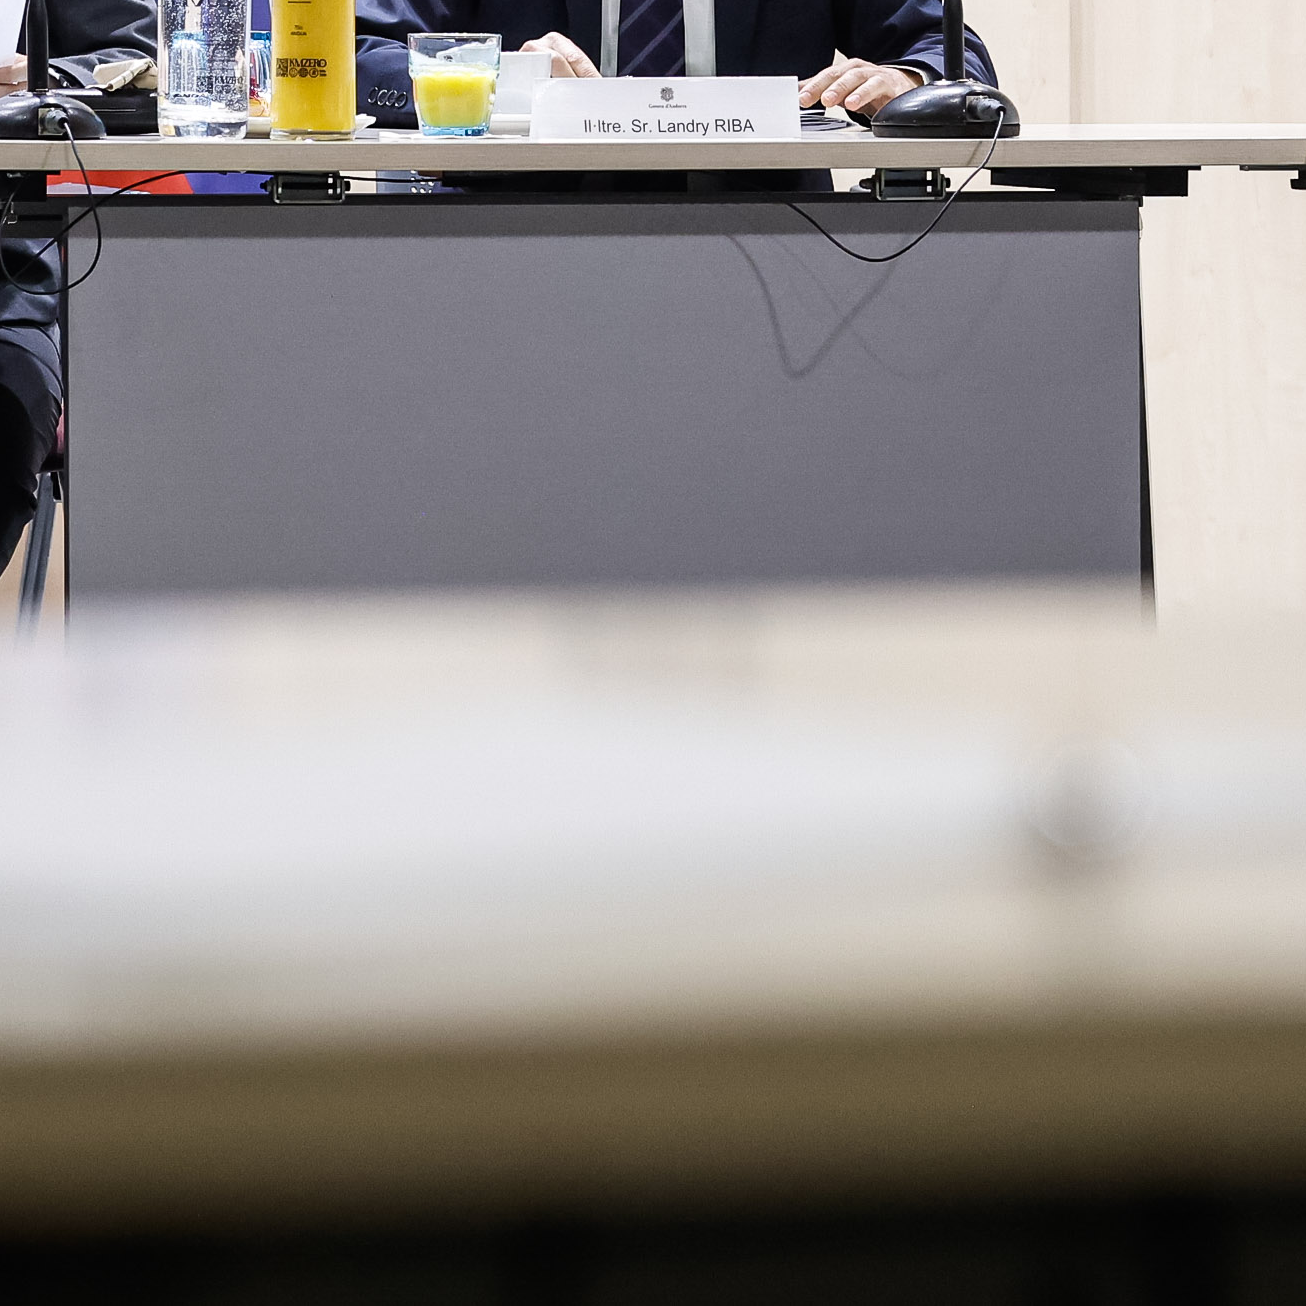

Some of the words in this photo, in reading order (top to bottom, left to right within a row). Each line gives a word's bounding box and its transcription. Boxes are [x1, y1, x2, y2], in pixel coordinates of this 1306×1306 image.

[289, 58, 327, 68] KMZERO
[631, 118, 653, 133] Sr.
[657, 119, 710, 136] Landry
[714, 119, 755, 133] RIBA
